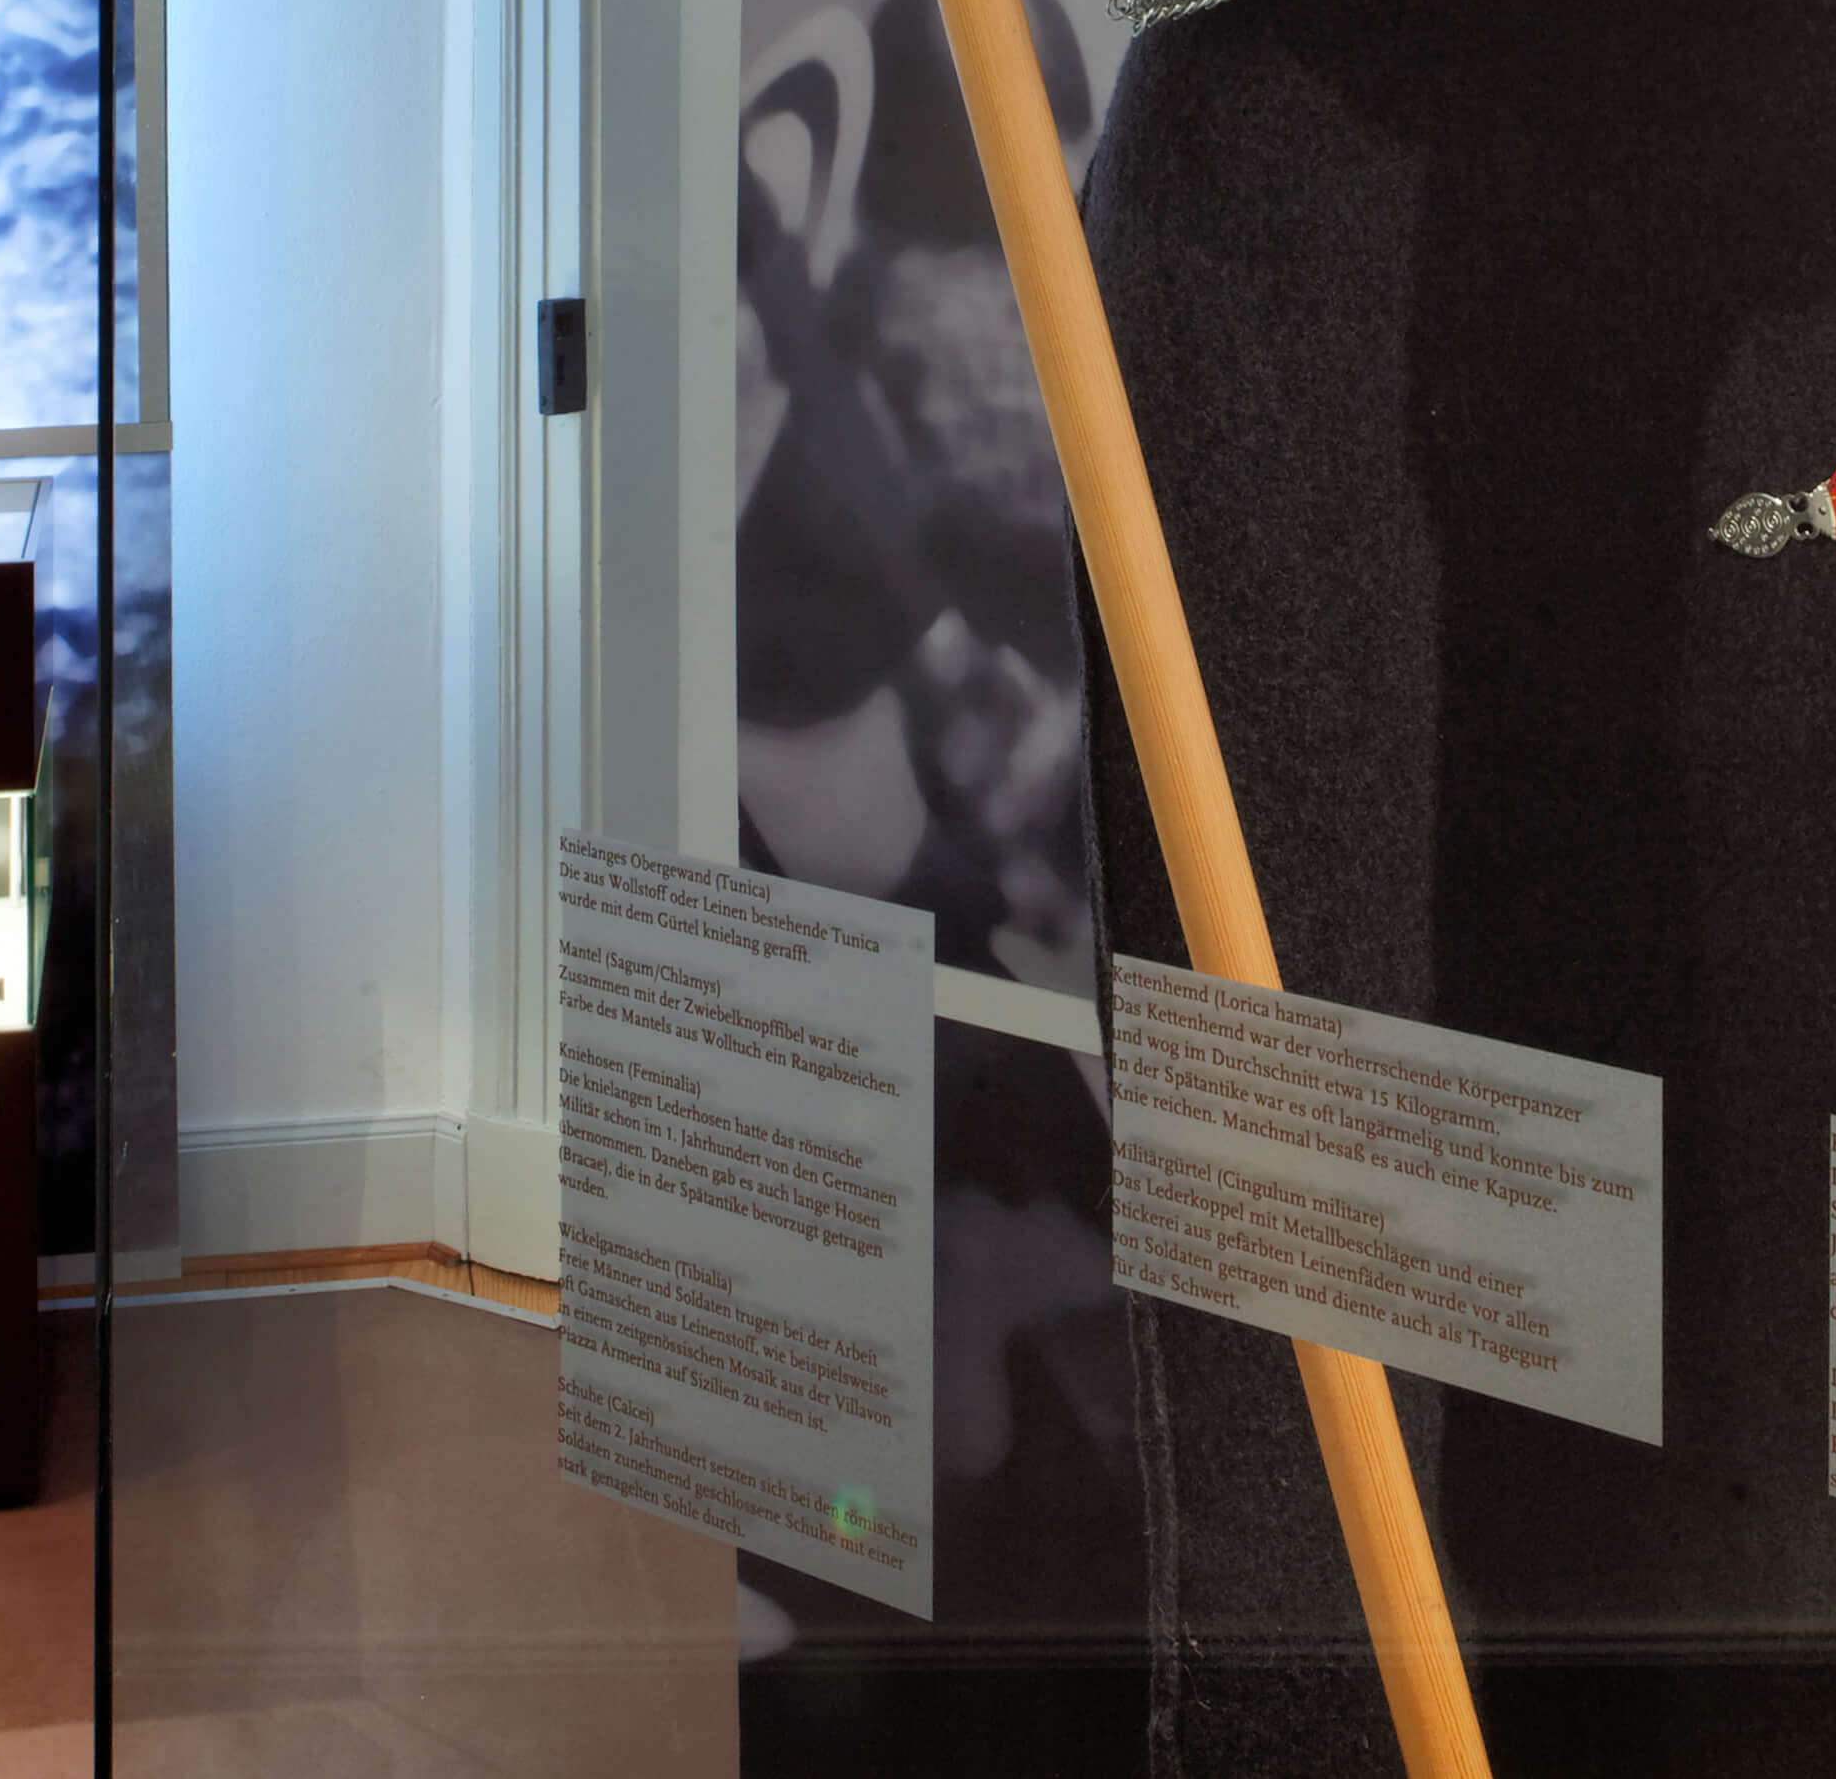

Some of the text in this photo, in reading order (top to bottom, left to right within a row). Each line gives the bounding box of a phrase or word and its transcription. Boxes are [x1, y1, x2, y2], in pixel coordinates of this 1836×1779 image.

[558, 860, 880, 953] Die aus Wollstoff oder Leinen bestehende Tunica
[559, 835, 771, 904] Knielanges Obergewand (Tunica)
[557, 890, 597, 910] wurde
[599, 899, 623, 917] mit
[624, 902, 654, 925] dem
[656, 911, 699, 936] Gürtel
[702, 920, 760, 955] knielang
[1110, 964, 1342, 1039] Kettenhemd (Lorica hamata)
[1110, 993, 1580, 1123] Das Kettenhemd war der vorherrschende Körperpanzer
[1114, 1027, 1499, 1135] und wog im Durchschnitt etwa 15 Kilogramm.
[1110, 1078, 1557, 1213] Knie reichen. Manchmal besaß es auch eine Kapuze.
[1113, 1052, 1634, 1201] In der Spätantike war es oft langärmelig und konnte bis zum
